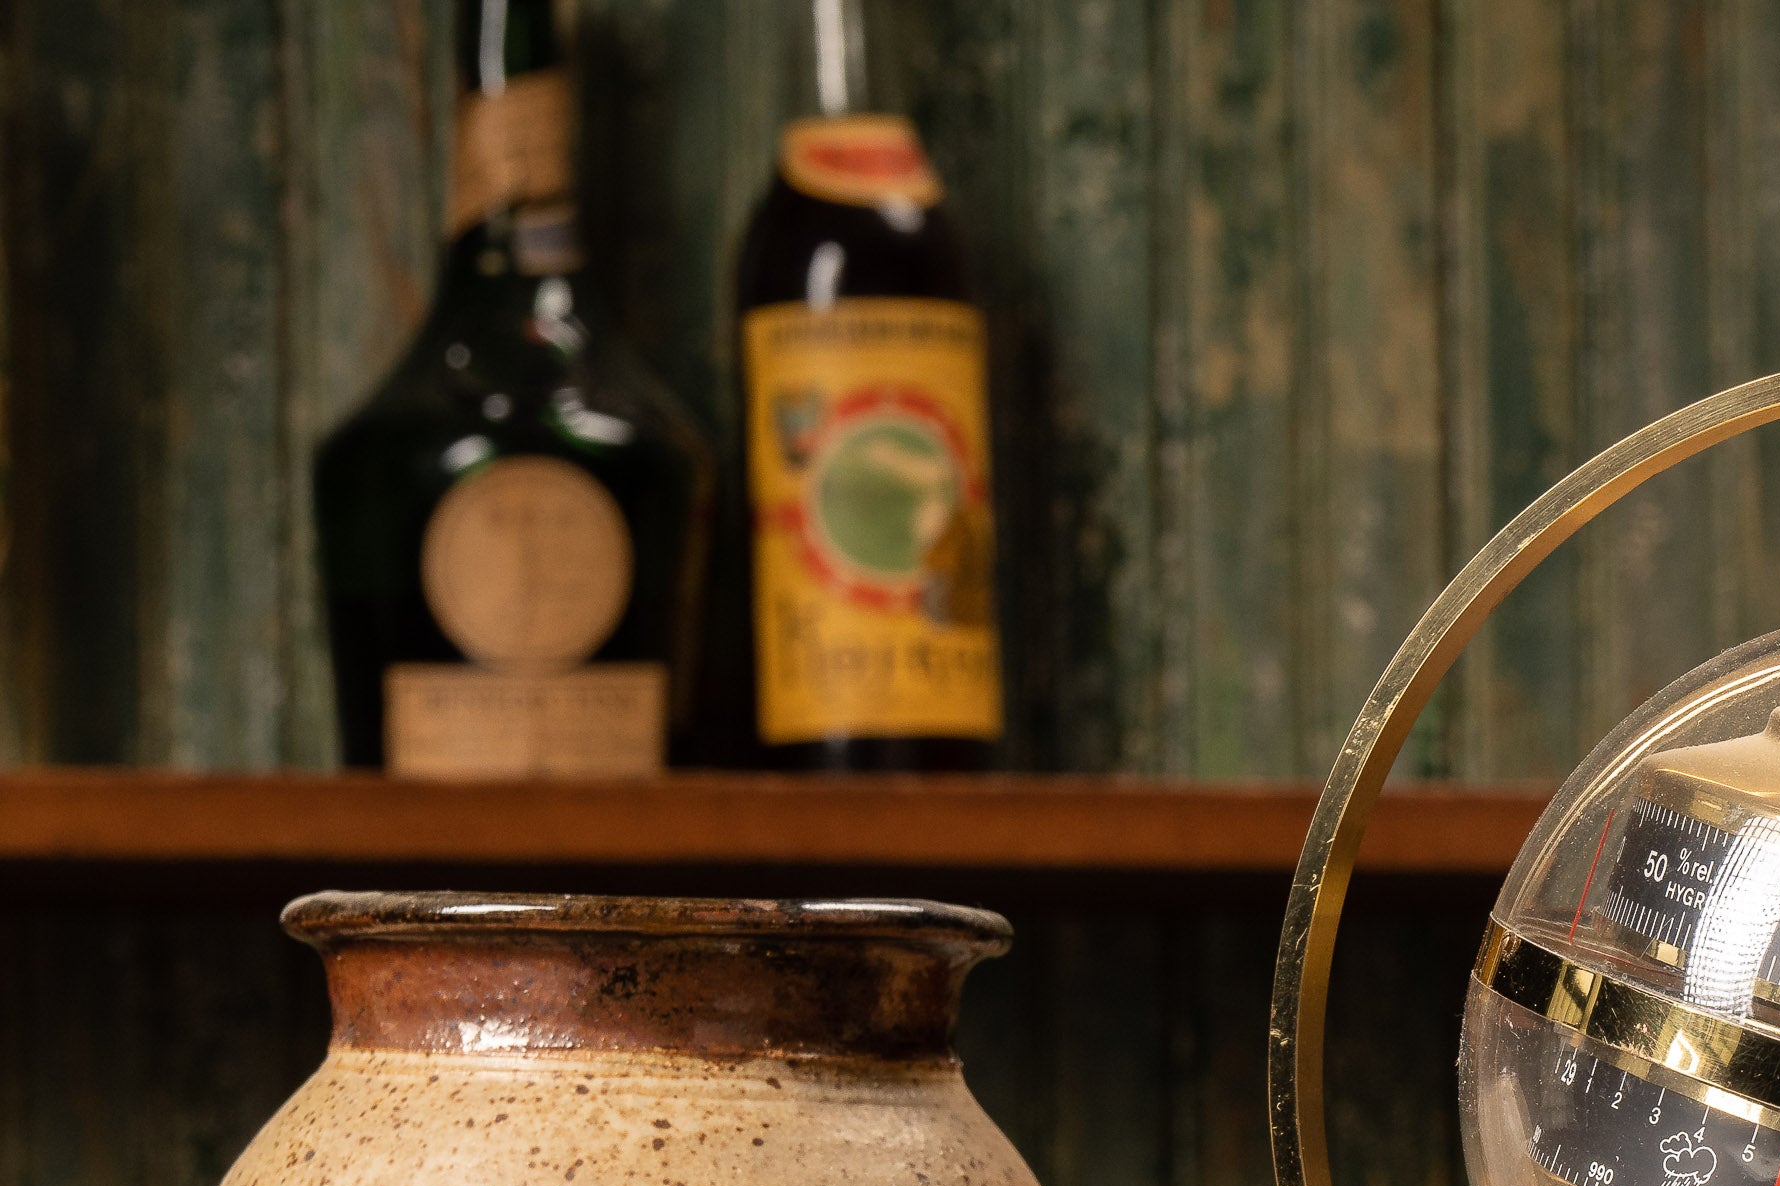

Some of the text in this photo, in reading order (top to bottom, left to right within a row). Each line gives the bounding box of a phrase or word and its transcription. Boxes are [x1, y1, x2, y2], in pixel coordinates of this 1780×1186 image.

[1643, 850, 1668, 882] 50
[1561, 1059, 1577, 1085] 29
[1586, 1077, 1593, 1093] 1
[1611, 1091, 1622, 1109] 2
[1649, 1107, 1662, 1125] 3
[1693, 1126, 1705, 1143] 4
[1742, 1145, 1757, 1163] 5
[1588, 1161, 1614, 1185] 990
